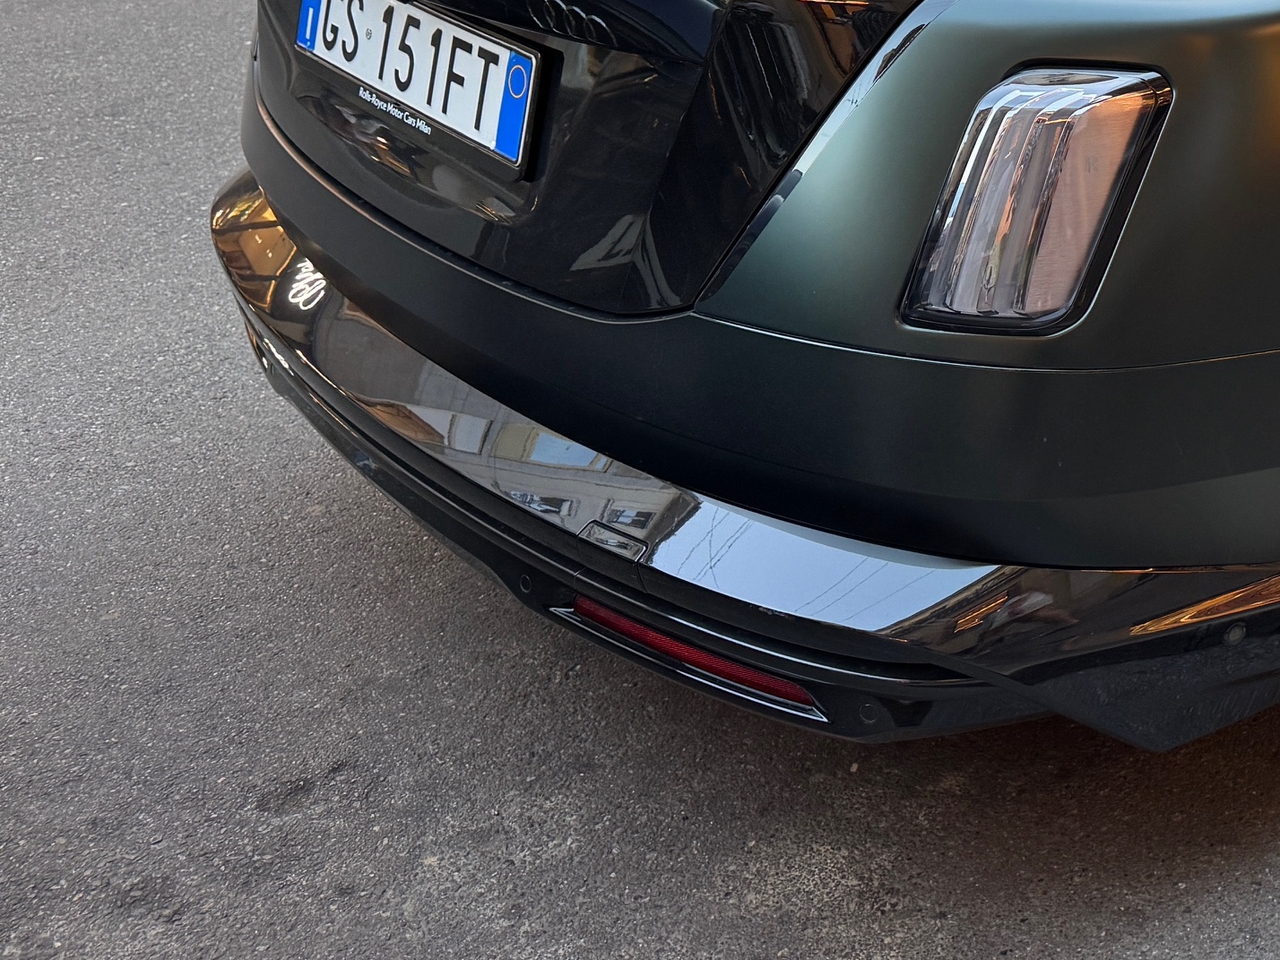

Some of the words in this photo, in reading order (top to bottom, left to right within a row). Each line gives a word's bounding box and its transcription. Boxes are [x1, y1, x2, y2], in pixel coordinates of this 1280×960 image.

[359, 86, 387, 111] Rolls-Royce
[386, 102, 403, 120] Motor
[403, 111, 417, 127] Cars
[415, 118, 432, 135] Milan
[377, 5, 500, 132] 151FT
